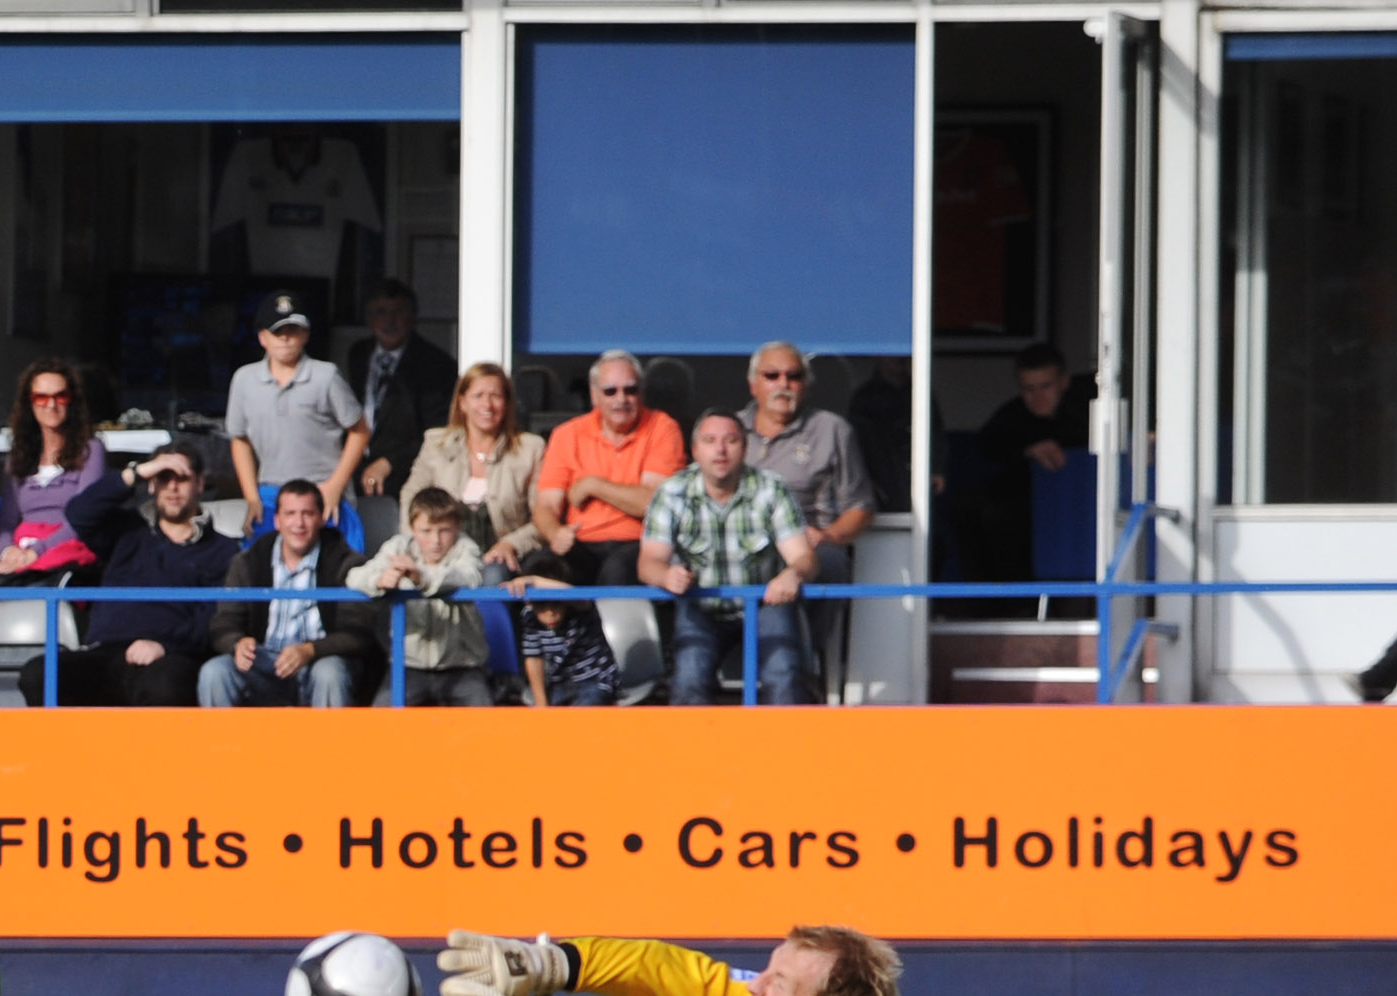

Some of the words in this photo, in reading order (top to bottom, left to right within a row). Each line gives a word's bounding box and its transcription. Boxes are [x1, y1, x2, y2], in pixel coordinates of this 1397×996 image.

[339, 817, 589, 870] Hotels
[677, 816, 861, 869] Cars
[953, 816, 1301, 883] Holidays
